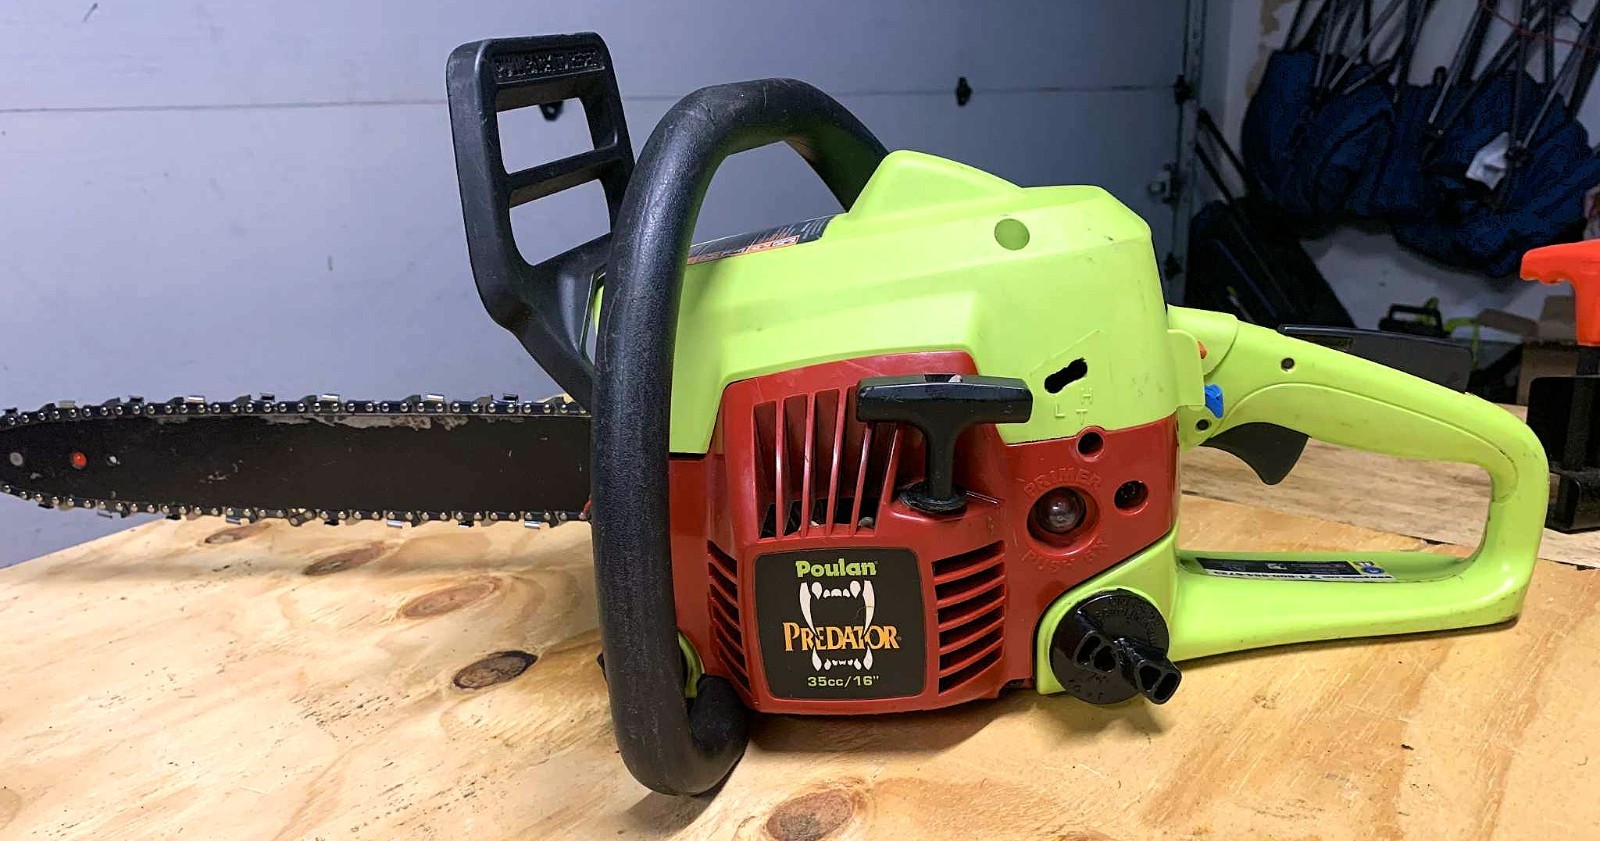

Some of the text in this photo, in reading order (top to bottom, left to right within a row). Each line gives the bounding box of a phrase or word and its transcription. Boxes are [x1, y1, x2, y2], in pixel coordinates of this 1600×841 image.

[1054, 400, 1066, 419] L
[1075, 408, 1088, 426] T
[1024, 467, 1102, 498] PRIMER
[796, 558, 877, 578] Poulan
[783, 622, 900, 651] PREDATOR
[807, 675, 879, 688] 35cc/16"
